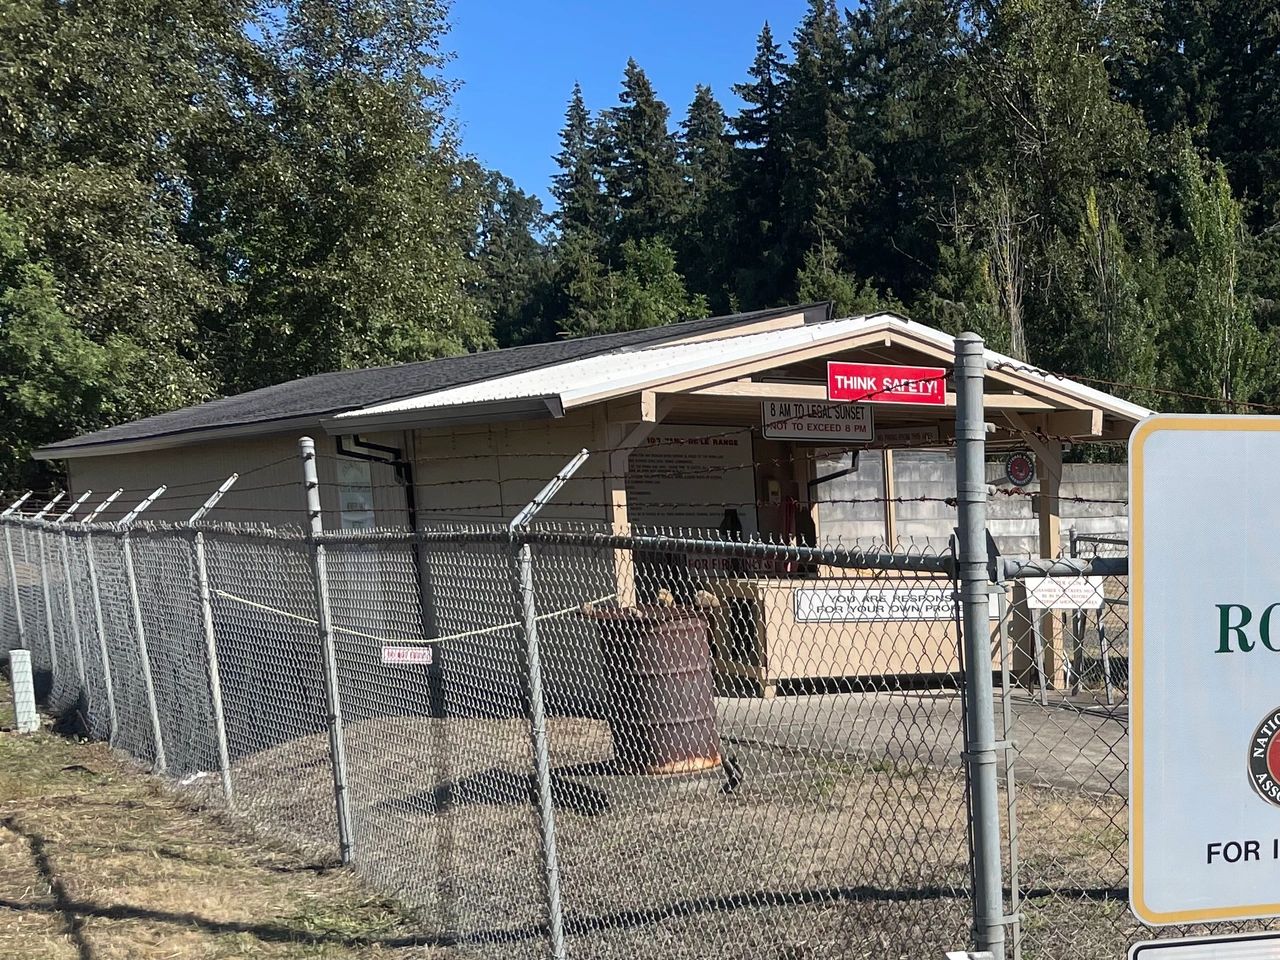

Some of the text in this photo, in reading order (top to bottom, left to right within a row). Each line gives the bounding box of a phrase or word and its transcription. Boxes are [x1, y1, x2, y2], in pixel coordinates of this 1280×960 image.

[834, 375, 938, 393] THINK SAFETY!
[770, 402, 865, 420] 8 AM TO LEGAL SUNSET
[770, 421, 867, 433] NOT TO EXCEED 8 PM
[829, 594, 855, 603] YOU
[862, 594, 887, 602] ARE
[816, 605, 844, 613] FOR
[850, 605, 885, 613] YOUR
[890, 605, 921, 613] OWN
[1207, 841, 1260, 864] FOR
